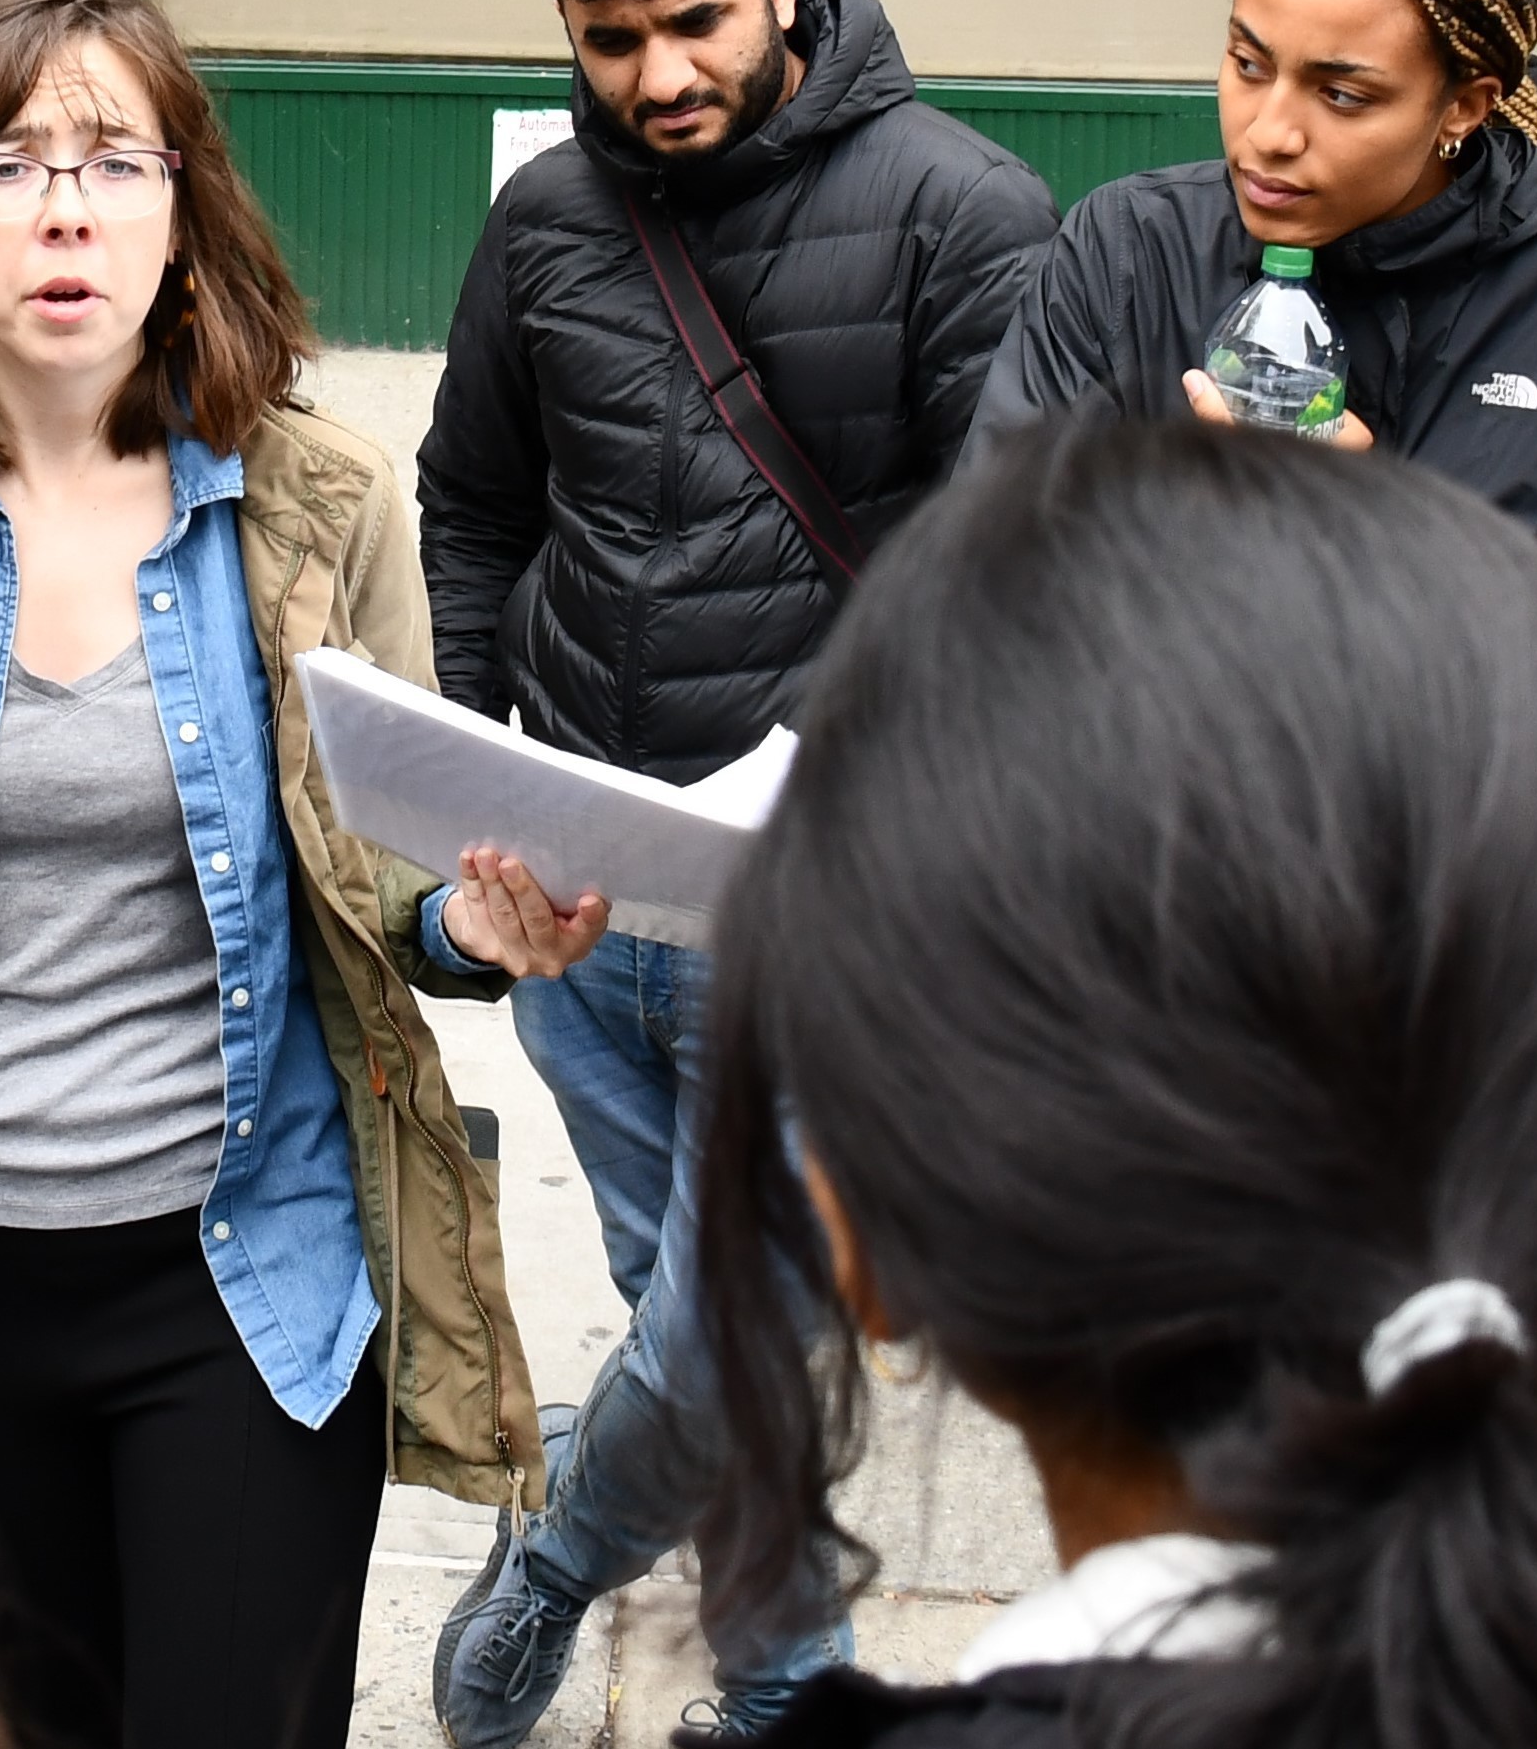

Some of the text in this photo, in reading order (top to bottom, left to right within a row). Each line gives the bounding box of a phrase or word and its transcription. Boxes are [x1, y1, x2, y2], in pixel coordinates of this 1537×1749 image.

[519, 115, 572, 132] Automat
[1492, 373, 1517, 385] THE
[1471, 383, 1514, 396] NORTH
[1481, 394, 1513, 405] FACE
